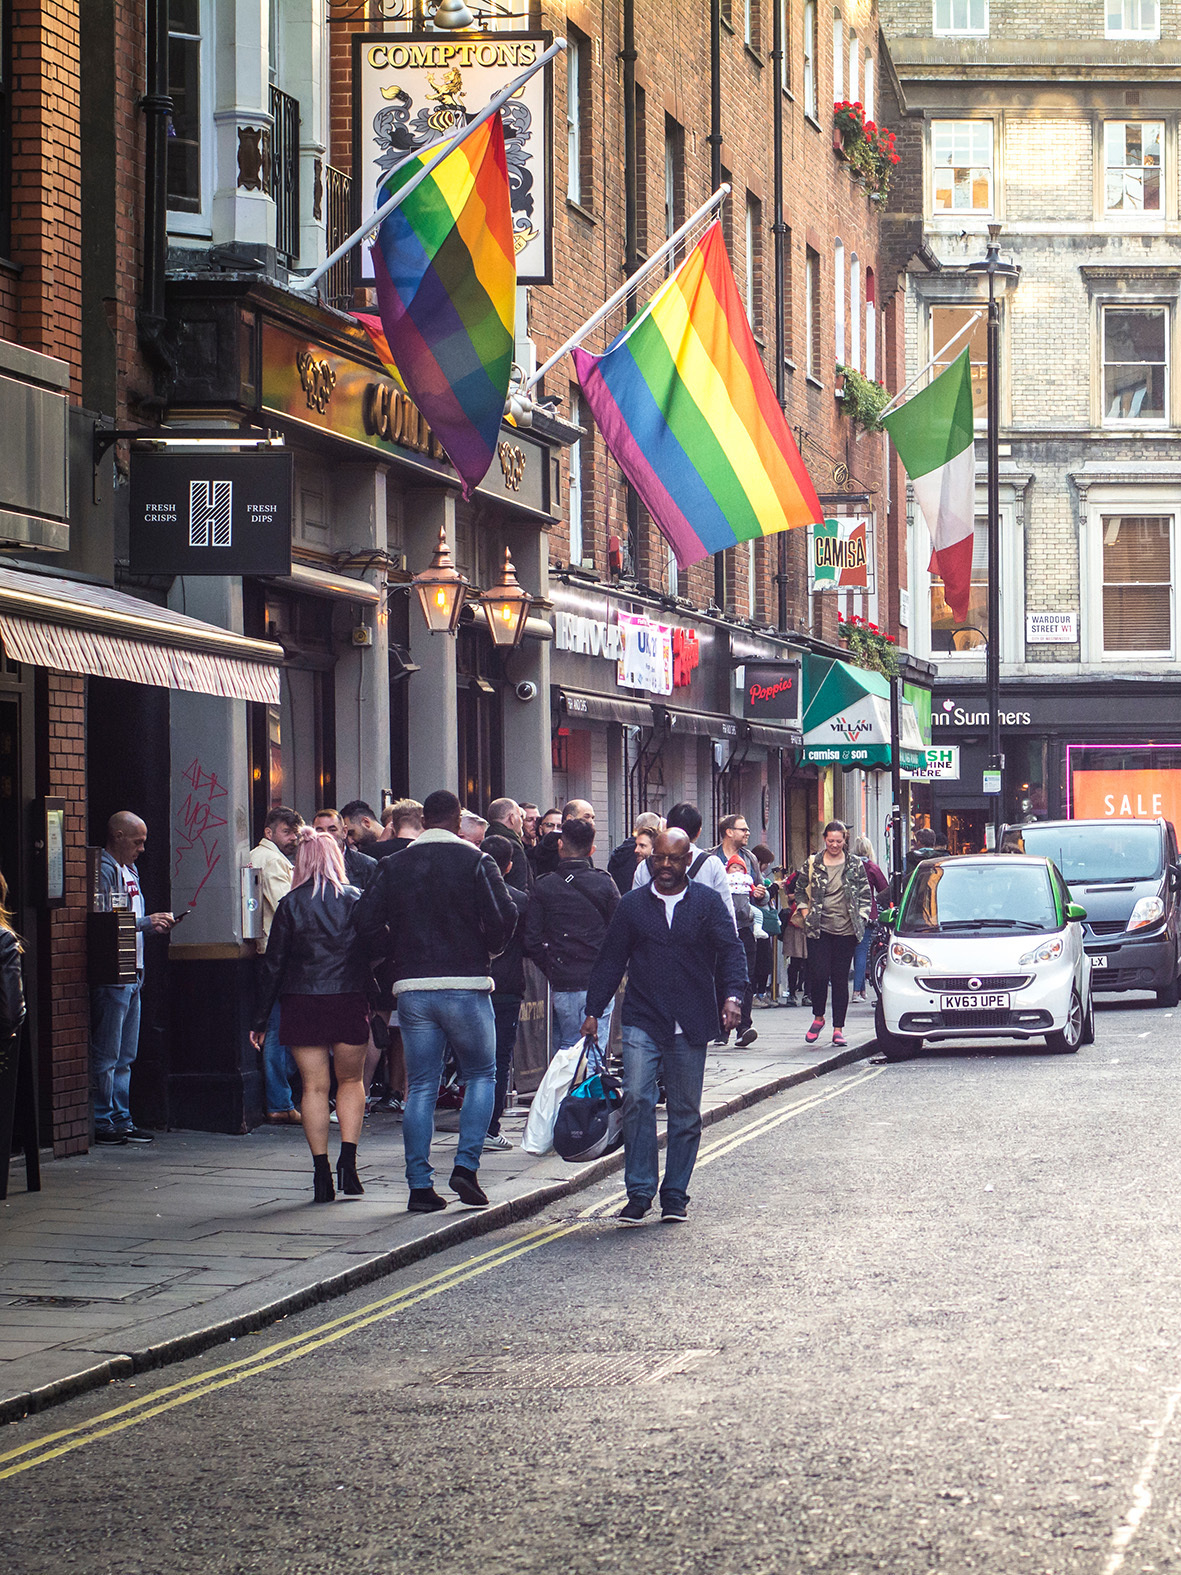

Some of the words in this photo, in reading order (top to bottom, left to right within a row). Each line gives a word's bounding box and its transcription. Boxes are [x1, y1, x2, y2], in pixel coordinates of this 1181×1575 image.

[367, 43, 537, 69] COMPTONS
[145, 504, 176, 512] FRESH
[246, 505, 277, 513] FRESH
[144, 514, 177, 522] CRISPS
[251, 515, 273, 523] DIPS
[815, 536, 867, 569] CAMISA
[1031, 625, 1058, 633] STREET
[749, 677, 793, 705] Poppies
[931, 713, 950, 726] nn
[830, 723, 873, 732] VILLANI
[808, 748, 840, 760] camisa
[851, 750, 868, 759] son
[927, 750, 953, 762] SH
[911, 769, 942, 777] HERE
[1104, 793, 1162, 816] SALE
[945, 996, 978, 1008] KV63
[980, 995, 1005, 1007] UPE
